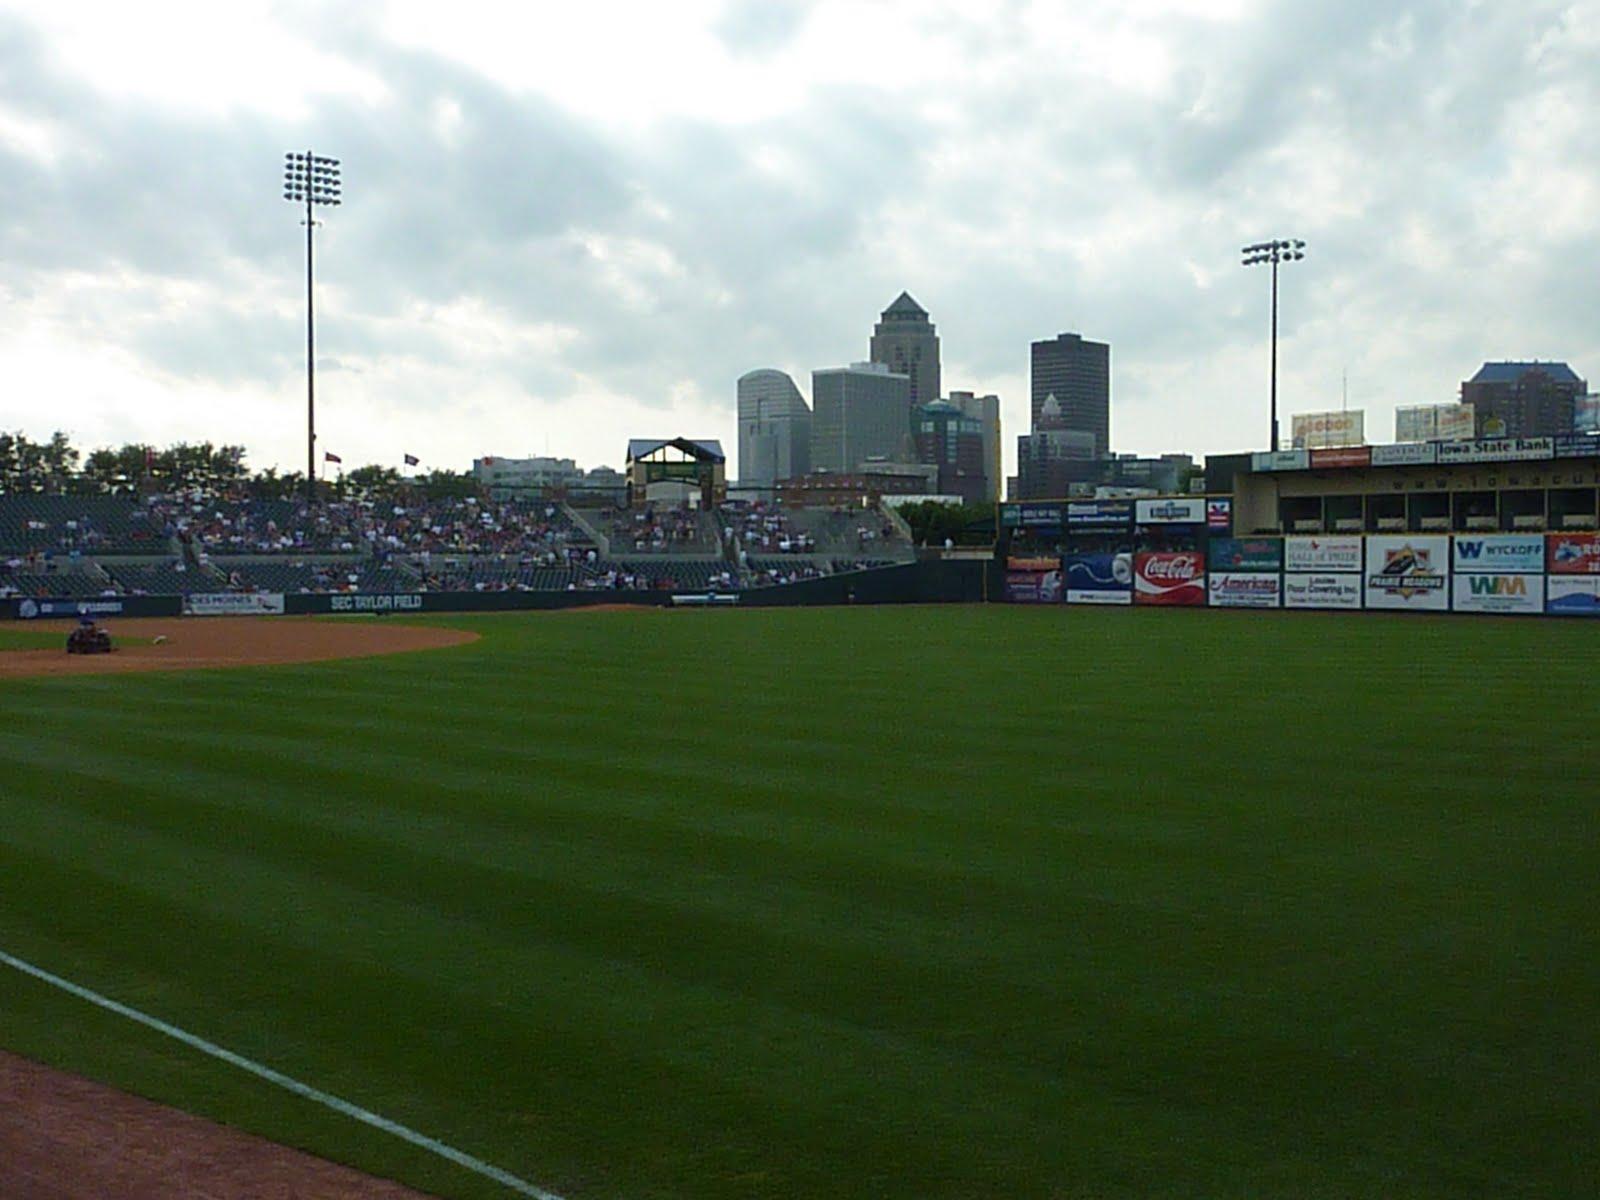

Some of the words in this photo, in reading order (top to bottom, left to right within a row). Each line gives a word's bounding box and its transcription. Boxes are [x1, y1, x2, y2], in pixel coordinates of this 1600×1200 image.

[1439, 443, 1470, 456] Iowa
[1474, 441, 1510, 454] State
[1515, 438, 1551, 452] Bank
[1485, 545, 1542, 556] WYCKOFF
[1144, 555, 1196, 579] Coca-Cola
[1210, 576, 1279, 593] American
[1469, 576, 1527, 595] WM
[331, 596, 353, 610] SEC
[354, 595, 392, 609] TAYLOR
[394, 595, 422, 608] FIELD
